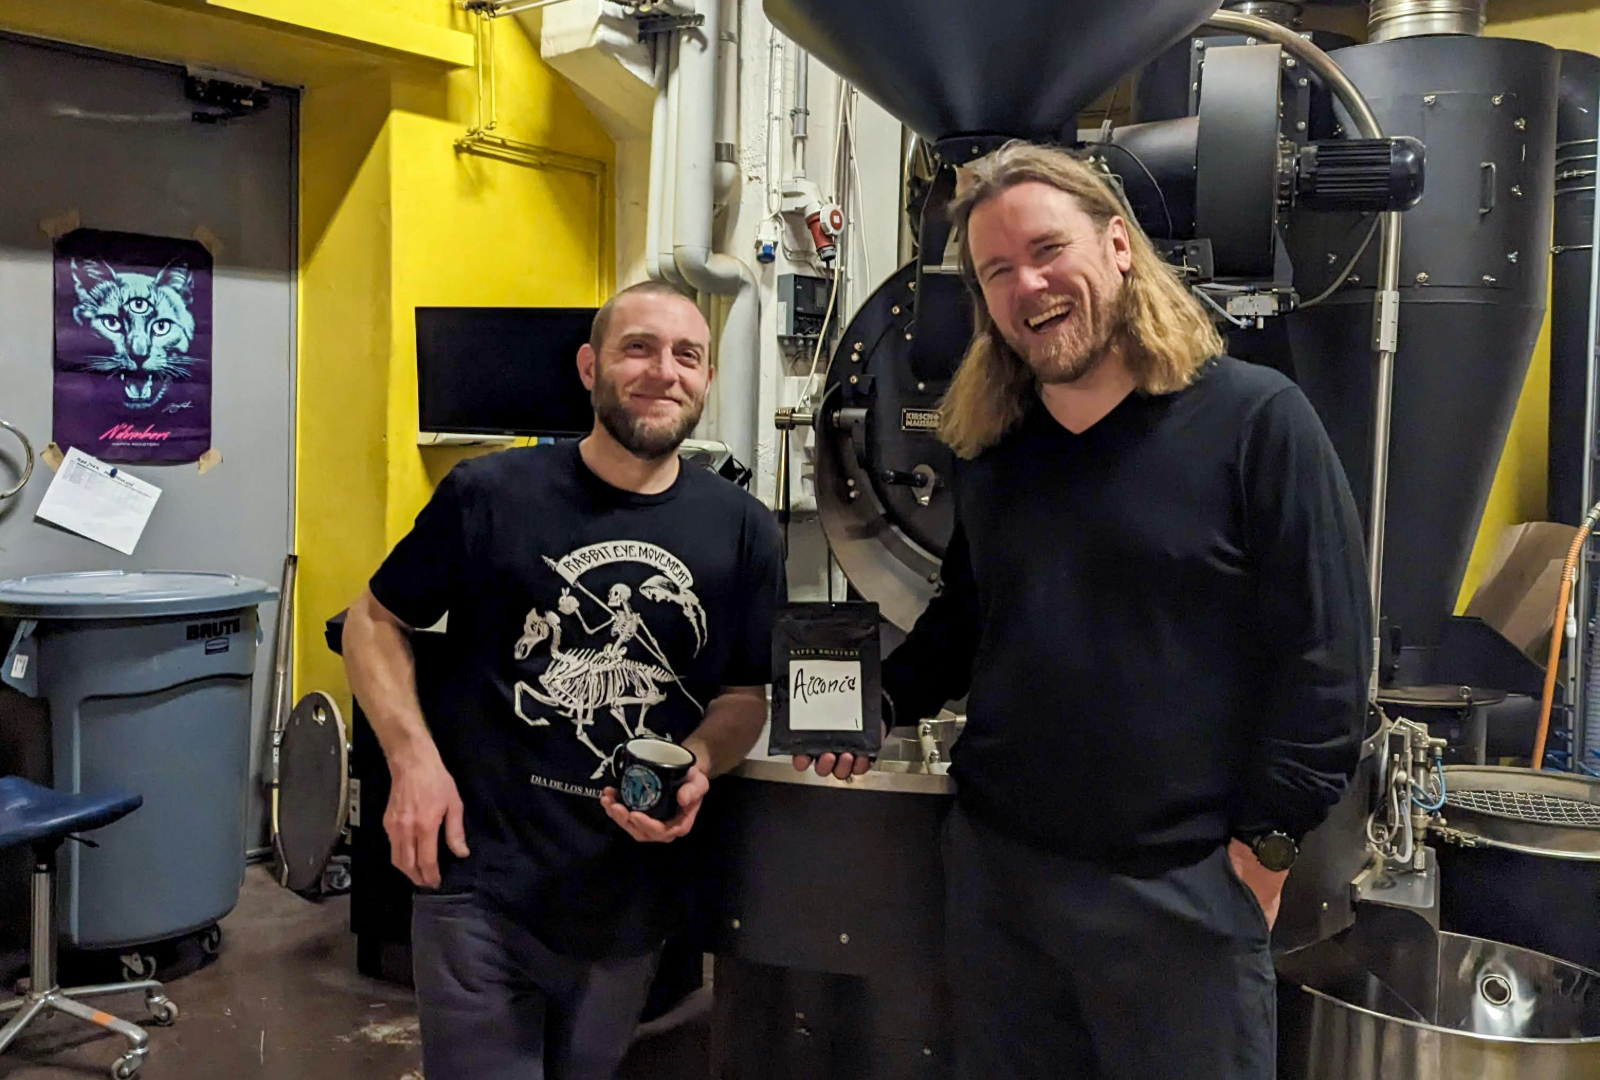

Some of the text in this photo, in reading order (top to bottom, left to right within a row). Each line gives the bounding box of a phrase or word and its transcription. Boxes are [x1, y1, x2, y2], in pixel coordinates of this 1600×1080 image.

[562, 545, 690, 585] RABBIT EYE MOVEMENT
[186, 618, 240, 640] BRUTE
[530, 774, 547, 787] DIA
[548, 779, 563, 791] DE
[564, 782, 582, 795] LOS
